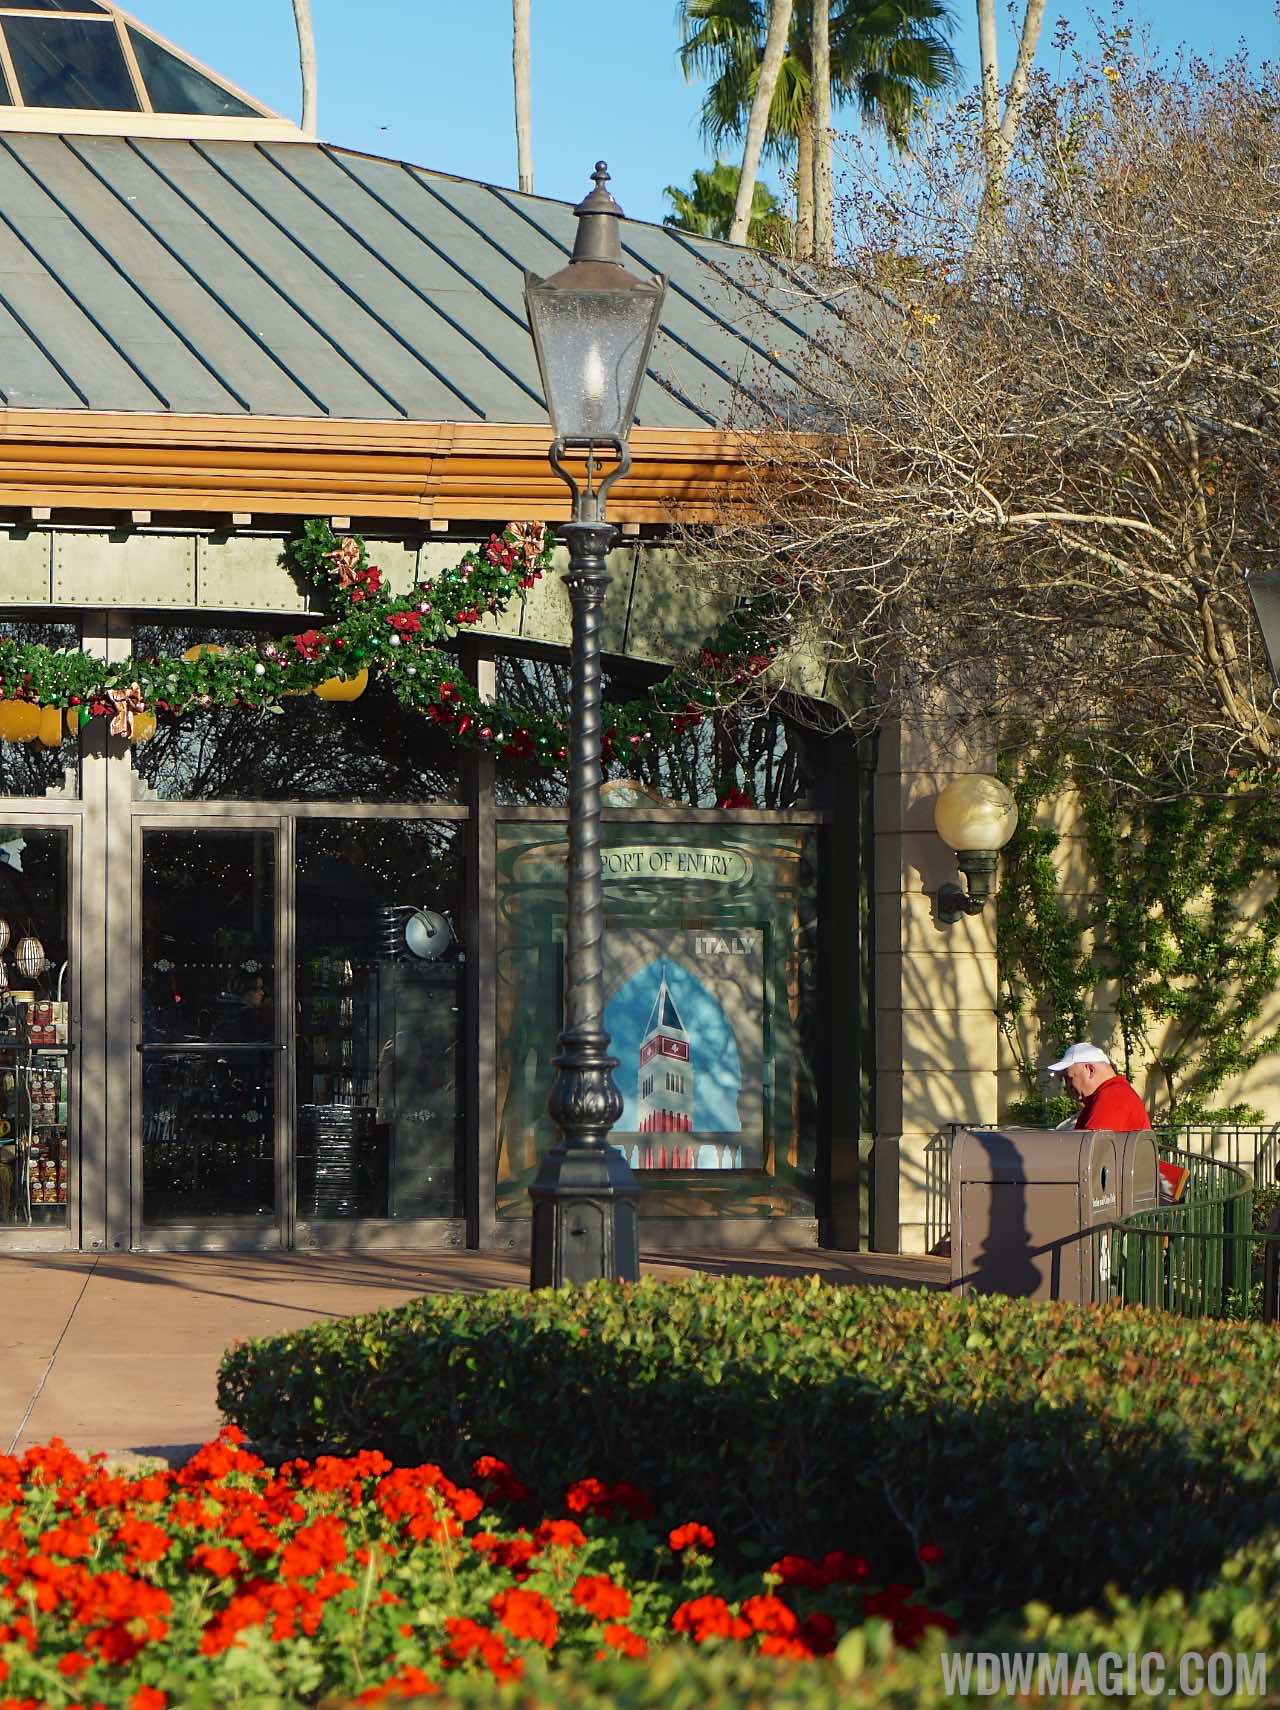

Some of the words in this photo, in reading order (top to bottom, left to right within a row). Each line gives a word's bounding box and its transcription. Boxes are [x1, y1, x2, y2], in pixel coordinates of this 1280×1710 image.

[600, 852, 644, 875] PORT
[649, 852, 672, 871] OF
[677, 852, 733, 876] ENTRY
[695, 936, 756, 955] ITALY
